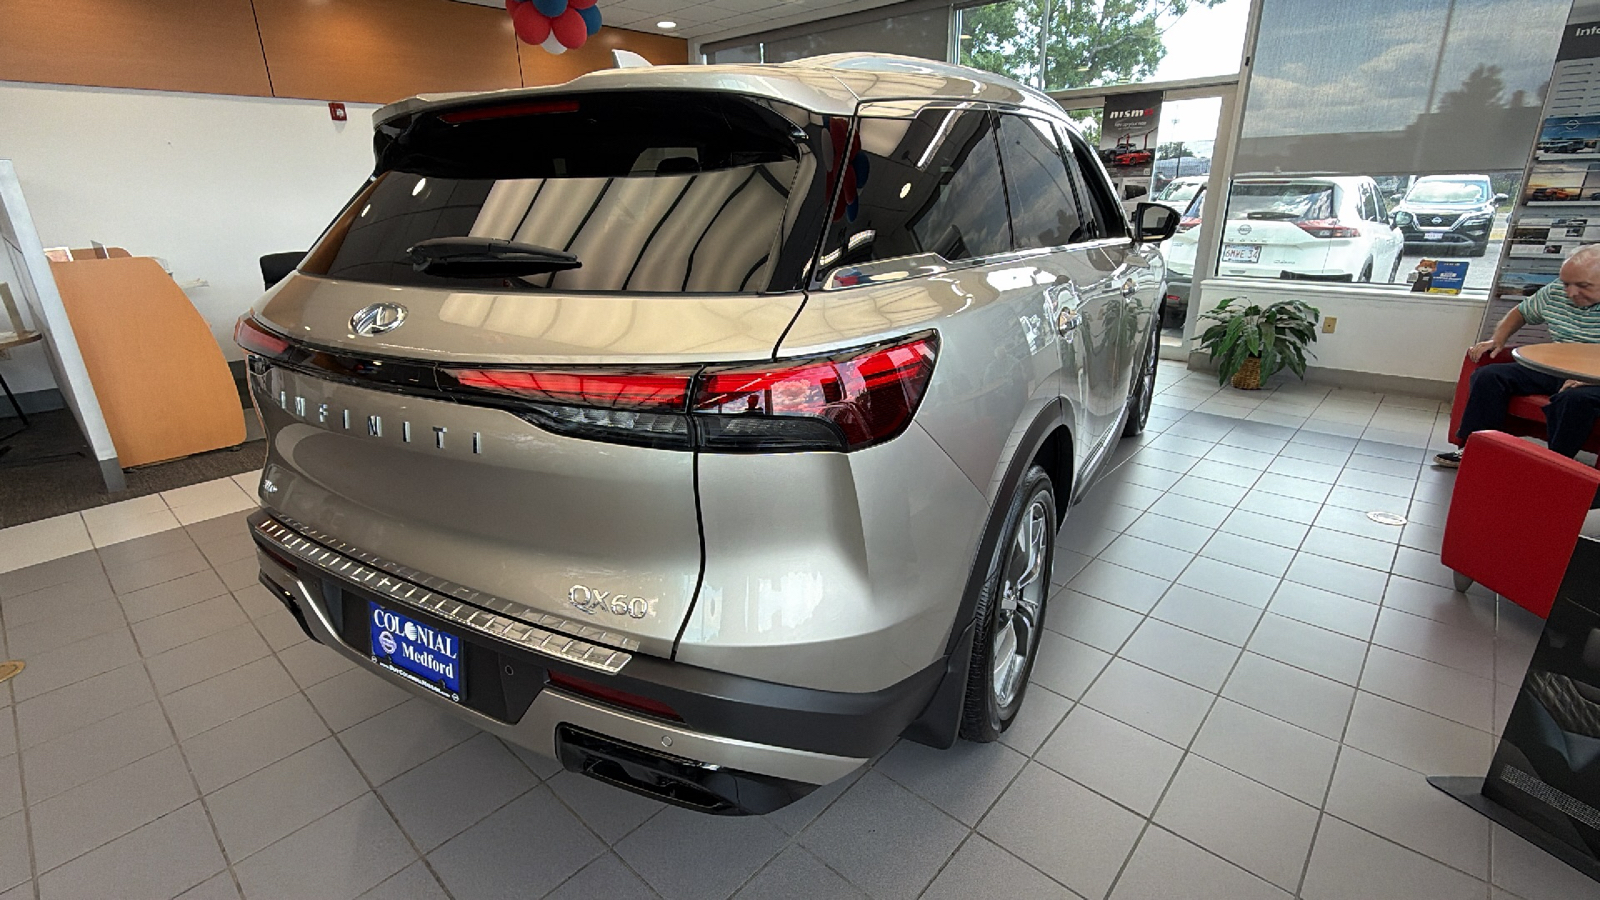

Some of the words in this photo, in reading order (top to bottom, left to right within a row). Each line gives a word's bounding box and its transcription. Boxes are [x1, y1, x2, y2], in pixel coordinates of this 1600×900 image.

[281, 391, 482, 454] INFINITI
[568, 584, 648, 619] QX60
[374, 608, 457, 659] COLONIAL
[402, 641, 454, 679] Medford
